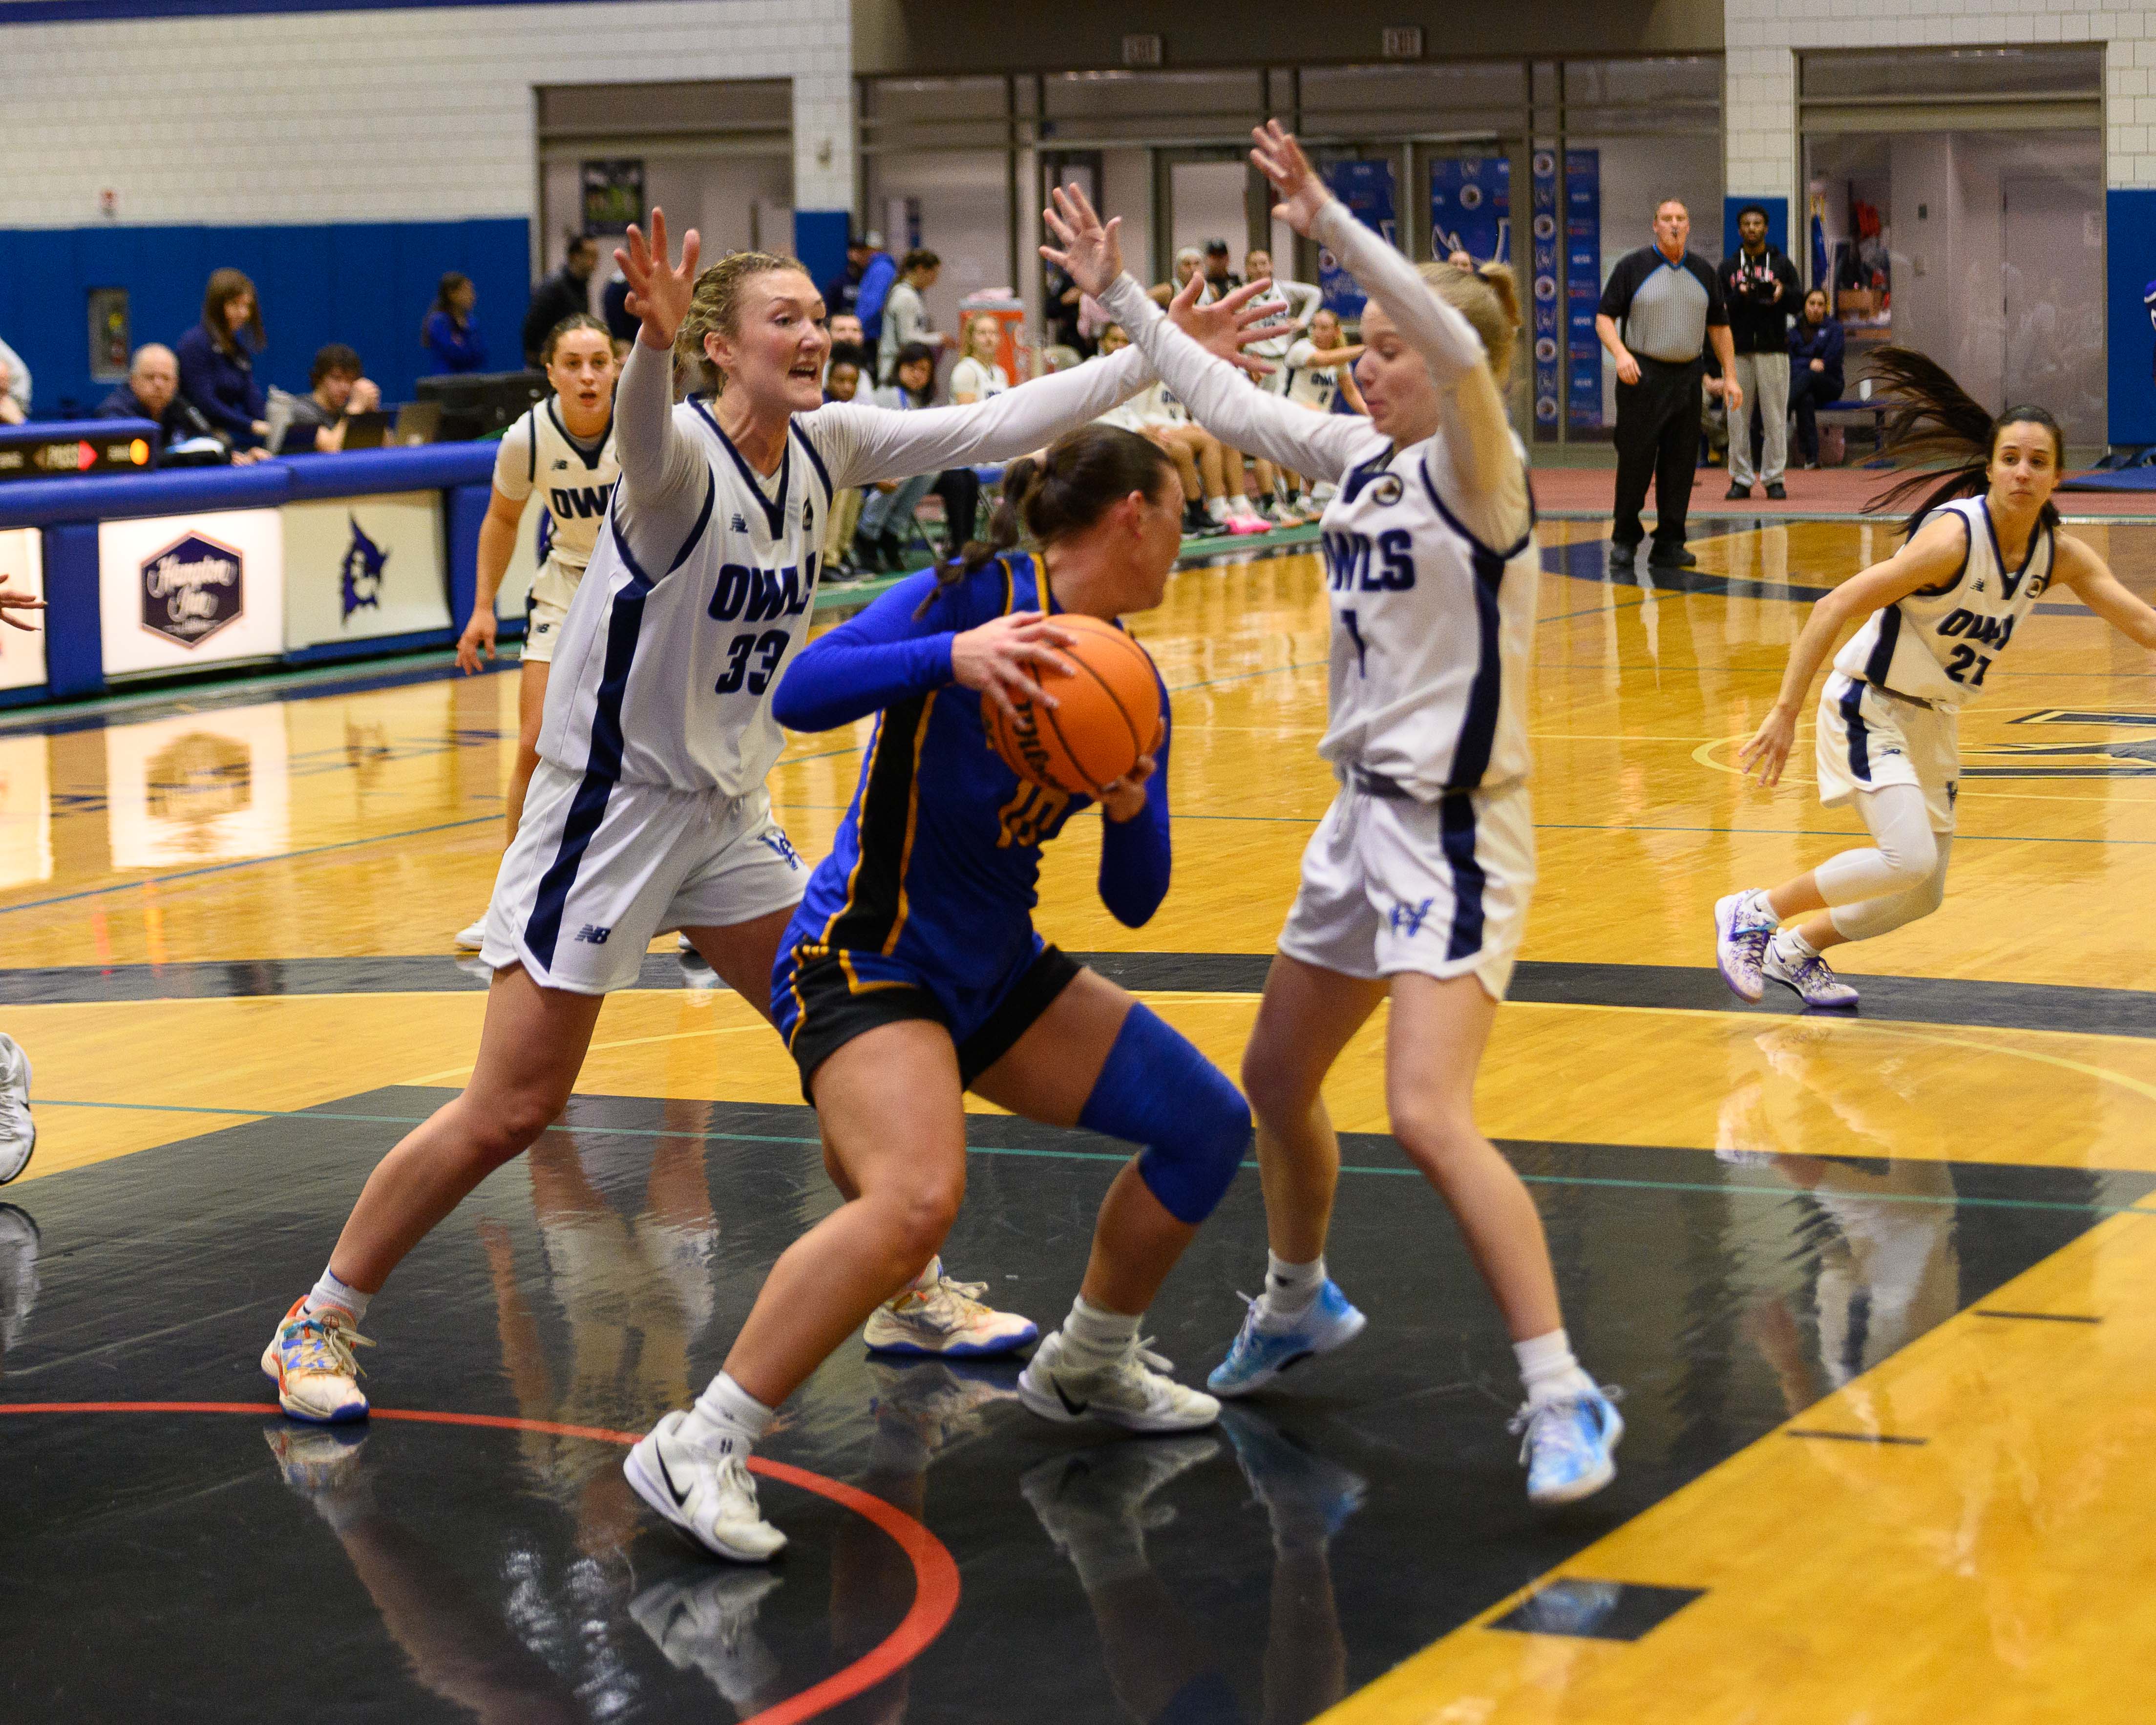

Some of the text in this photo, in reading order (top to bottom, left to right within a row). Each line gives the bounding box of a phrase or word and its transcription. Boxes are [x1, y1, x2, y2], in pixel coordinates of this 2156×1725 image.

[550, 483, 615, 519] OW
[1321, 528, 1415, 592] WLS
[715, 630, 790, 695] 33
[1944, 643, 1992, 686] 21
